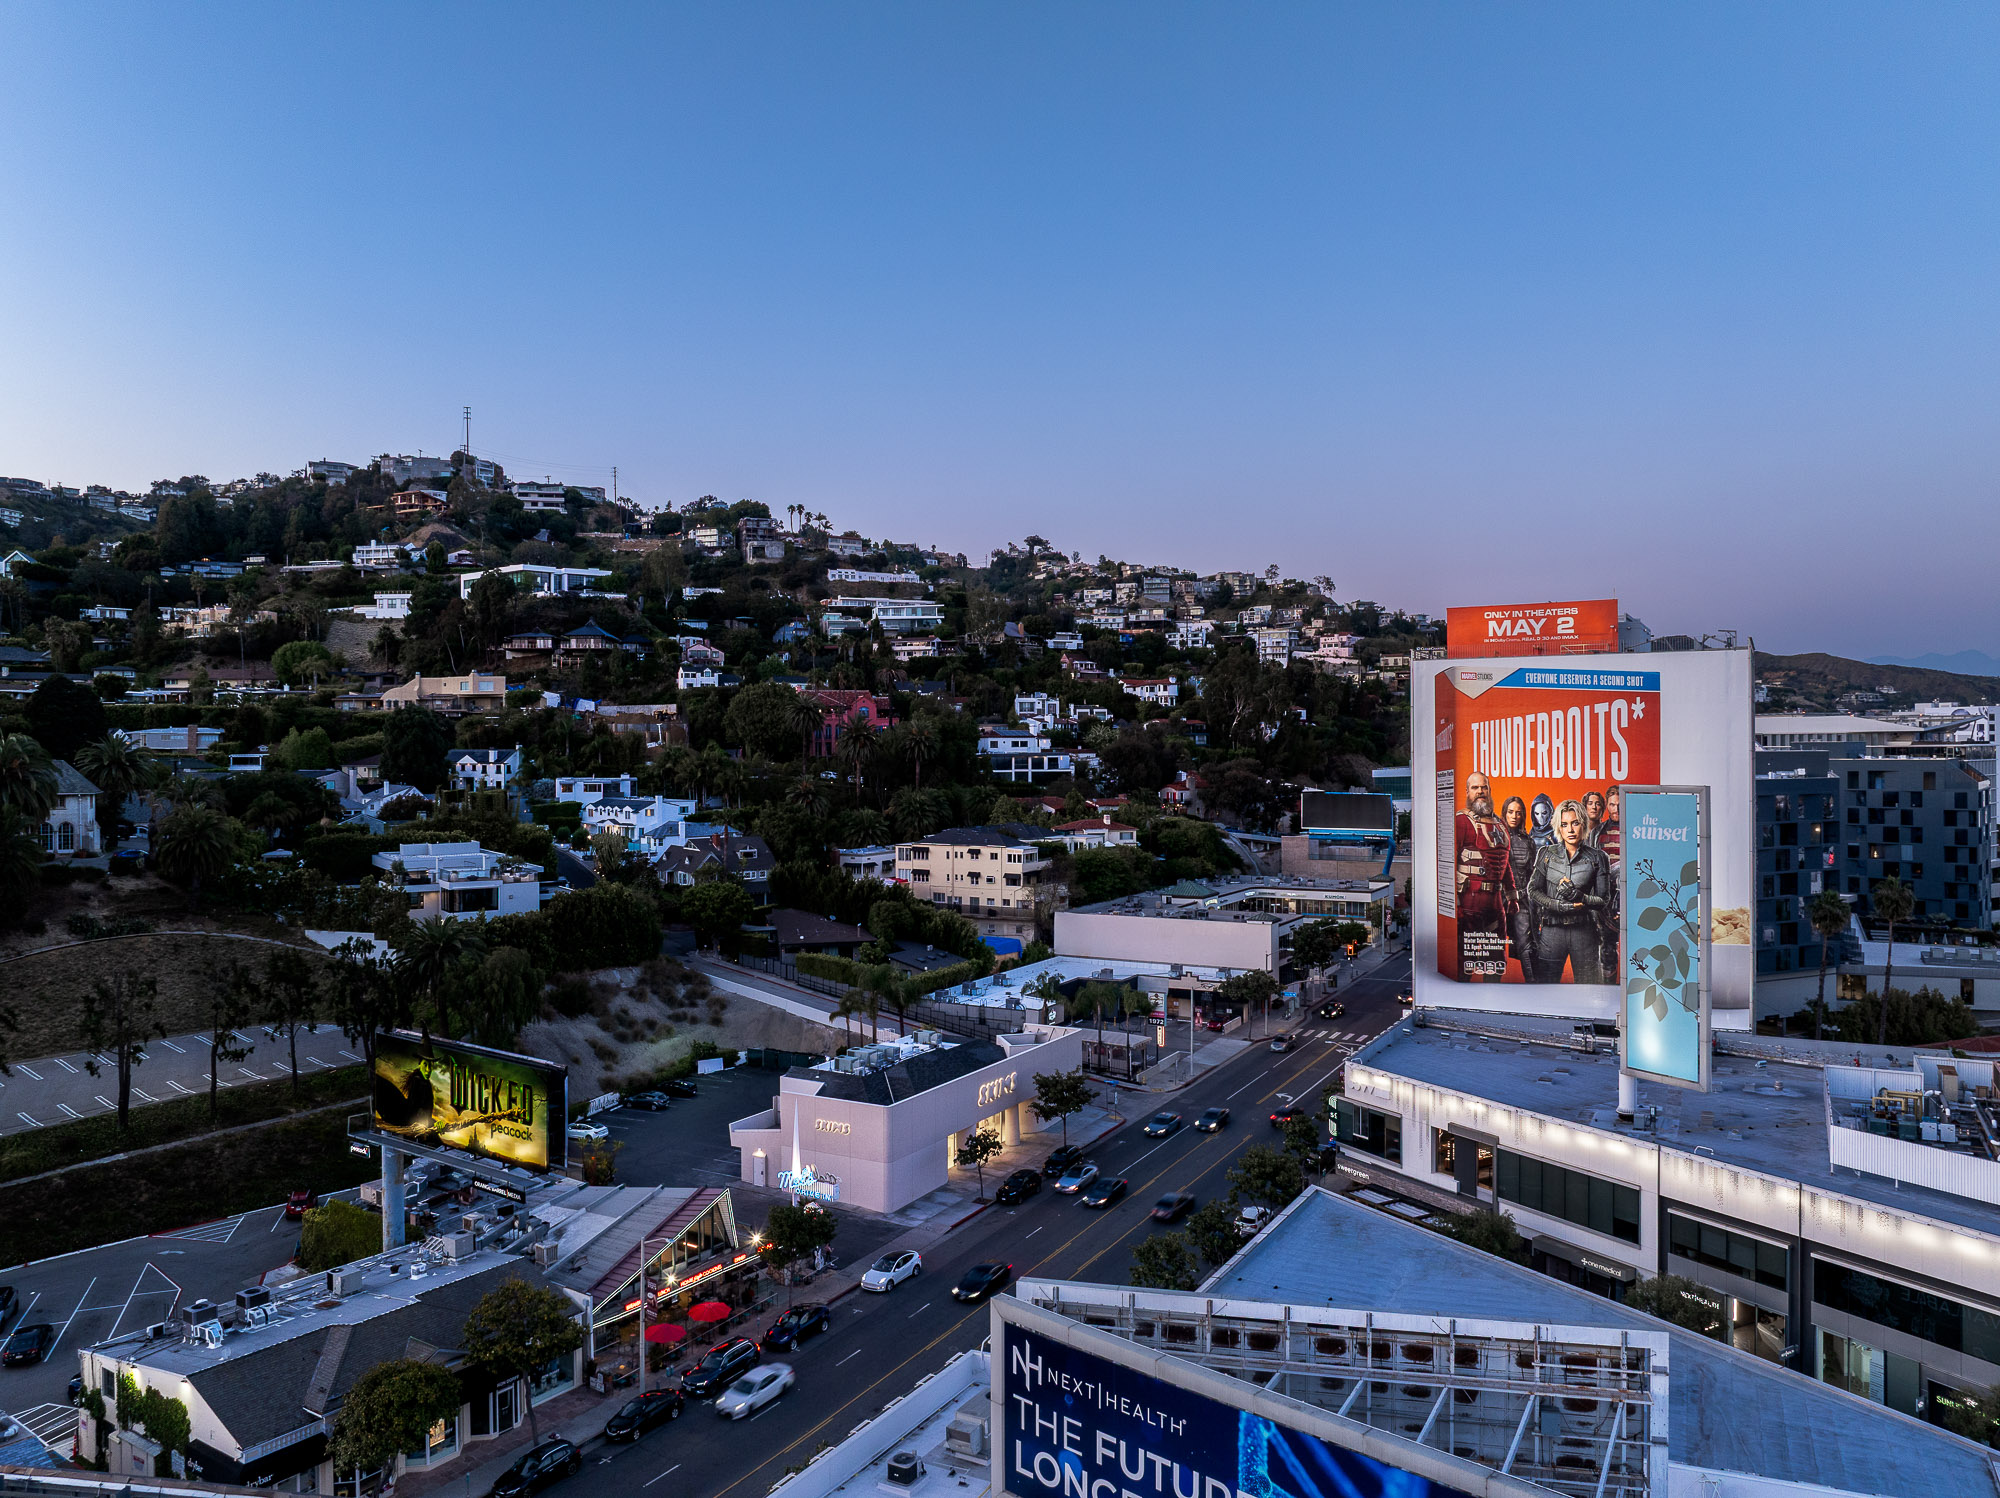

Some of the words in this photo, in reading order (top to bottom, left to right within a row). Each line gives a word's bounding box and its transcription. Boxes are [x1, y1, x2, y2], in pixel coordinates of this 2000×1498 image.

[1484, 610, 1510, 619] ONLY
[1512, 610, 1522, 618] IN
[1524, 607, 1579, 617] THEATERS
[1488, 617, 1548, 637] MAY
[1557, 616, 1575, 634] 2
[1461, 672, 1477, 681] MARVEL
[1477, 672, 1494, 681] STUDIOS
[1525, 672, 1558, 684] EVERYONE
[1559, 673, 1591, 685] DESERVES
[1593, 675, 1599, 686] A
[1599, 675, 1625, 687] SECOND
[1626, 675, 1644, 687] SHOT
[1642, 813, 1659, 826] the
[1632, 825, 1692, 842] sunset
[450, 1058, 534, 1127] WICKED
[490, 1123, 534, 1142] peacock
[814, 1118, 851, 1136] SKIMS
[1337, 1163, 1370, 1180] sweetgreen
[1587, 1260, 1599, 1269] one
[1599, 1264, 1622, 1277] medical
[1012, 1393, 1083, 1457] THE
